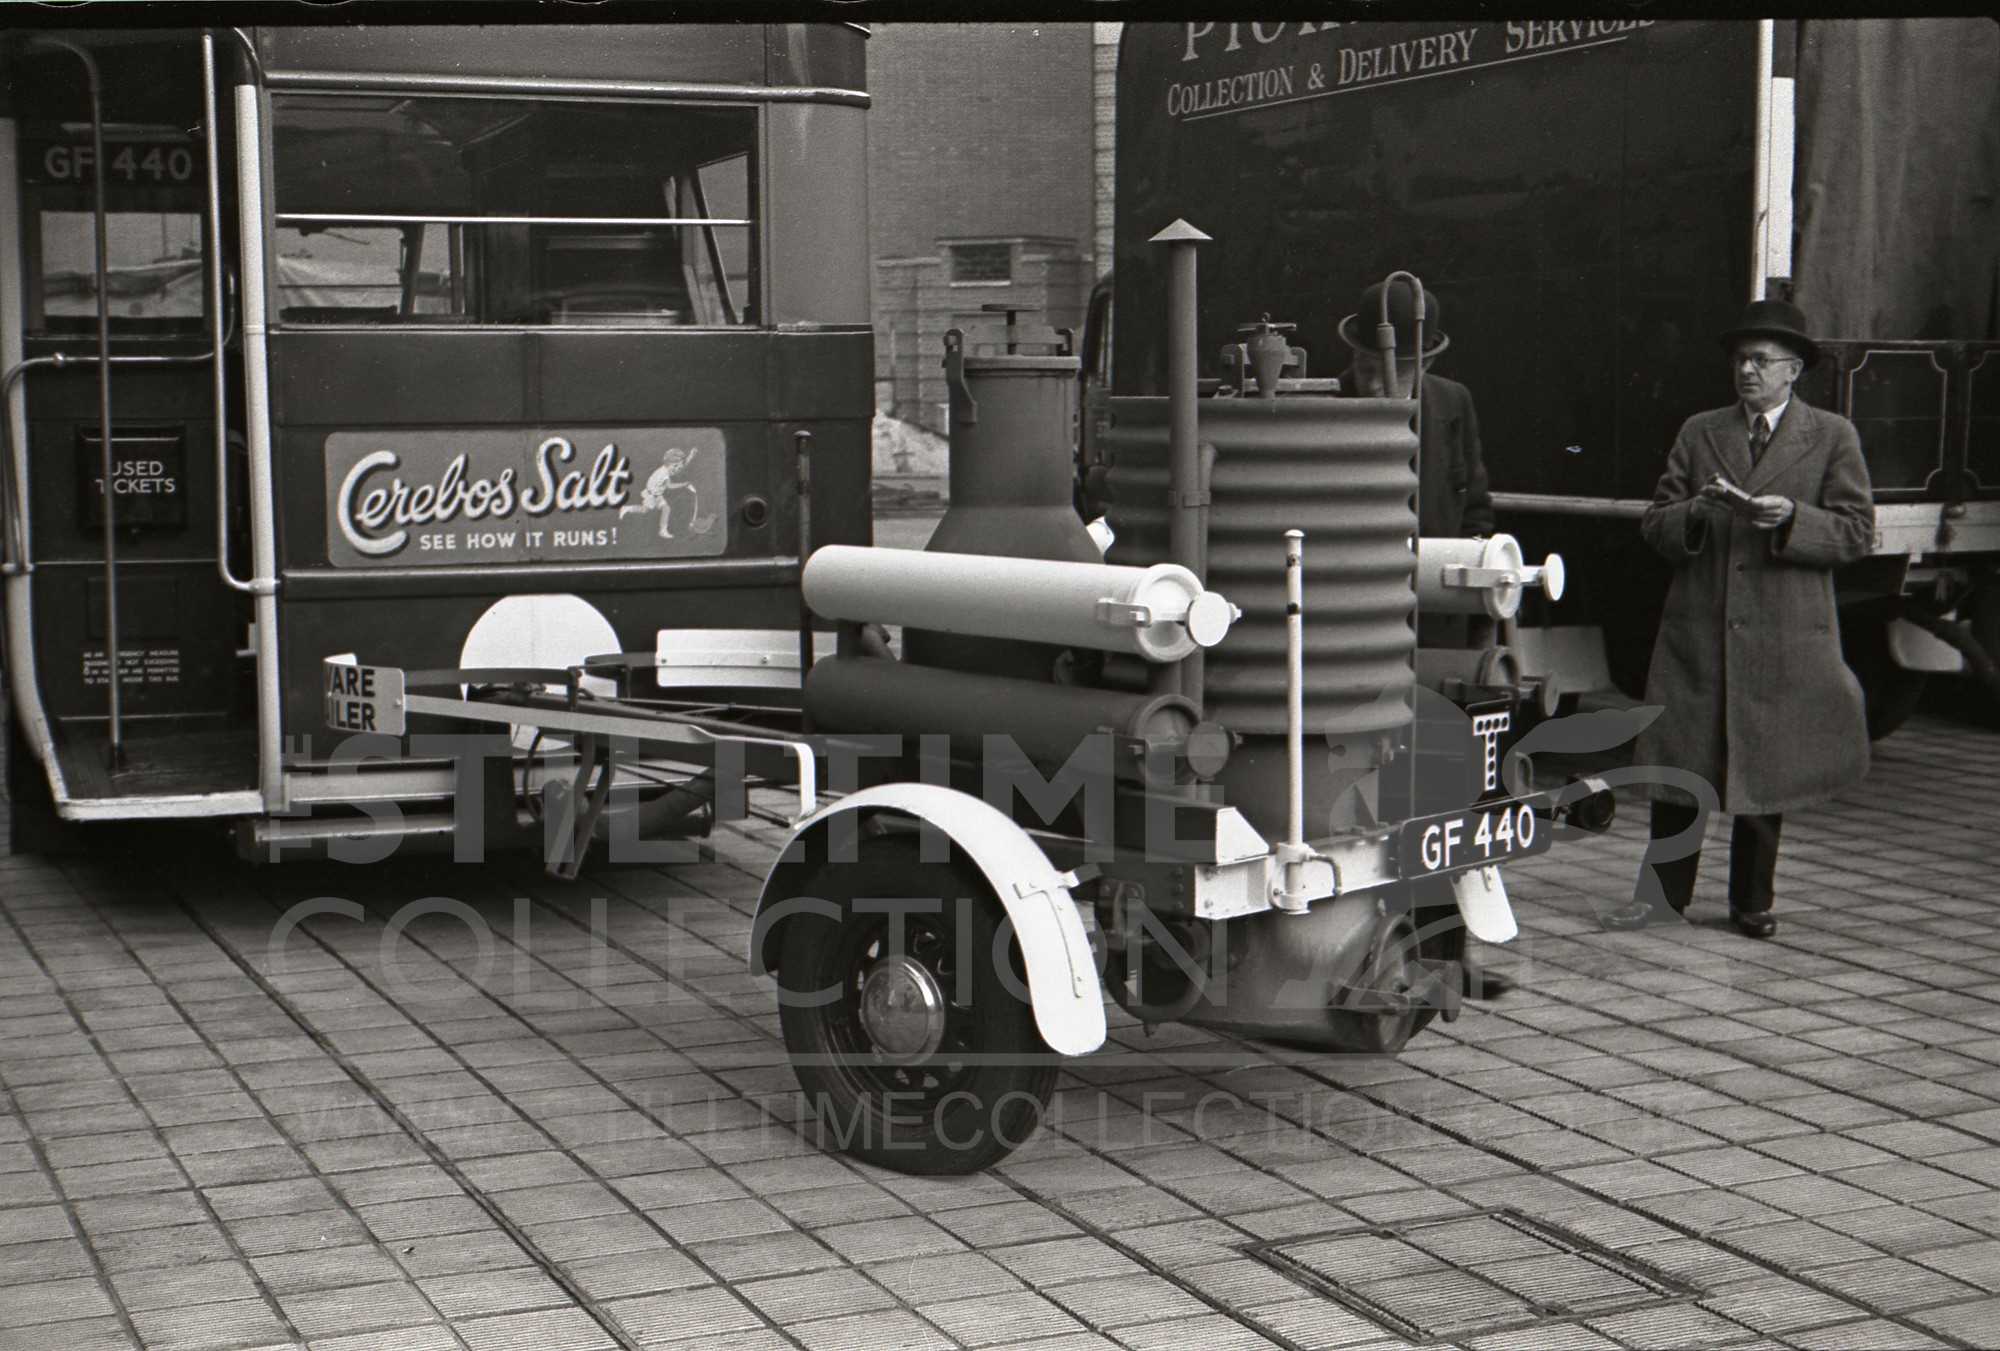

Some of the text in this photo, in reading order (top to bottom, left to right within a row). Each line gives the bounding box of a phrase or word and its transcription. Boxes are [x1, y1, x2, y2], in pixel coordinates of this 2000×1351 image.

[1167, 65, 1295, 116] COLLECTION
[1307, 63, 1326, 90] &
[1337, 28, 1478, 86] DELIVERY
[44, 146, 192, 180] GF 440
[95, 478, 176, 494] TCKETS
[338, 436, 630, 555] Cerebos Salt
[420, 528, 618, 550] SEE HOW IT RUNS!
[1472, 711, 1510, 791] T
[1421, 804, 1535, 870] GF 440
